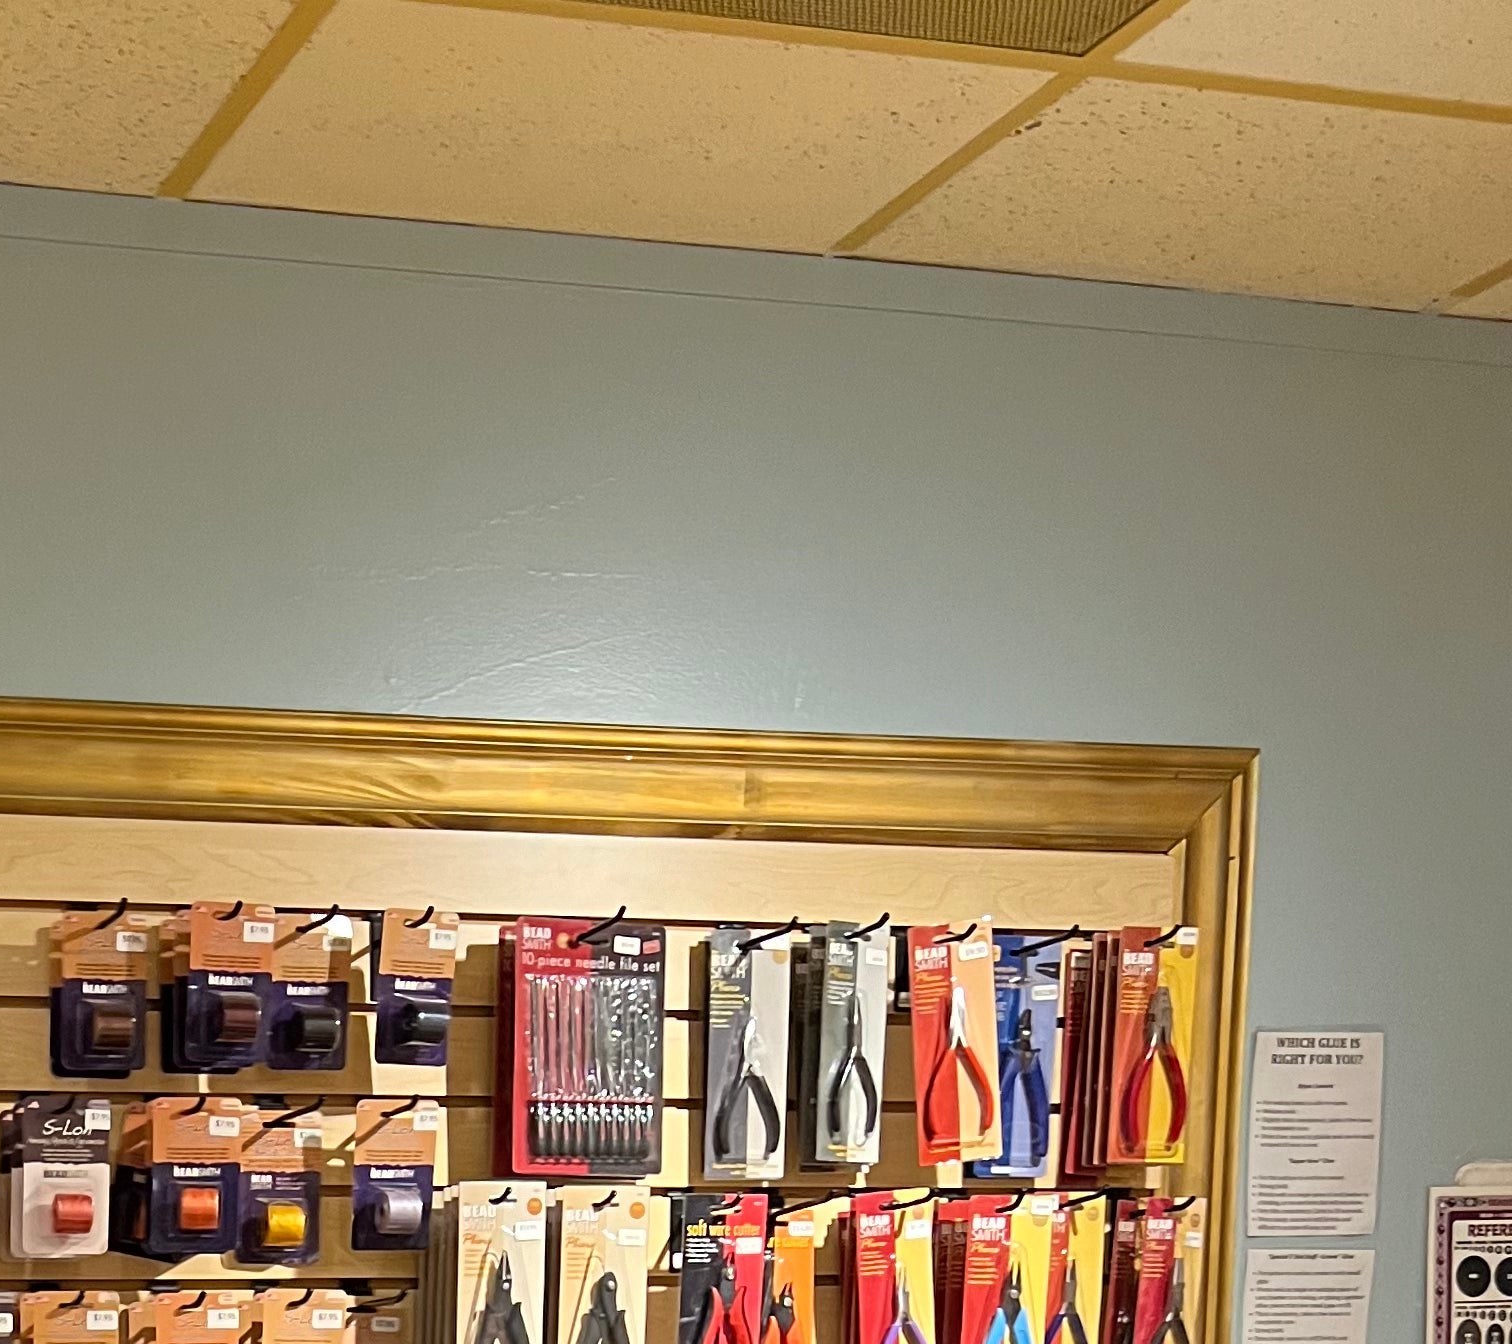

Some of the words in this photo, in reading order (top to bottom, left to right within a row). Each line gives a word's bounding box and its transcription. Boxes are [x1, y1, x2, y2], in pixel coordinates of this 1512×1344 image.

[522, 926, 552, 939] BEAD
[914, 945, 948, 960] BEAD
[1122, 952, 1155, 965] BEAD
[521, 952, 571, 969] 10-piece
[576, 956, 616, 970] needle
[620, 958, 638, 972] file
[643, 961, 660, 973] set
[914, 958, 949, 971] SMITH
[1276, 1037, 1315, 1048] WHICH
[1318, 1037, 1347, 1048] GLUE
[1350, 1038, 1360, 1049] IS
[1271, 1054, 1306, 1064] RIGHT
[1309, 1054, 1332, 1065] FOR
[1336, 1054, 1364, 1065] YOU?
[462, 1204, 497, 1218] BEAD
[565, 1208, 600, 1222] BEAD
[859, 1214, 891, 1227] BEAD
[972, 1216, 1006, 1229] BEAD
[687, 1219, 707, 1236] soft
[709, 1223, 730, 1236] wire
[733, 1223, 760, 1236] cutter
[859, 1226, 891, 1238] SMITH
[971, 1229, 1007, 1241] SMITH
